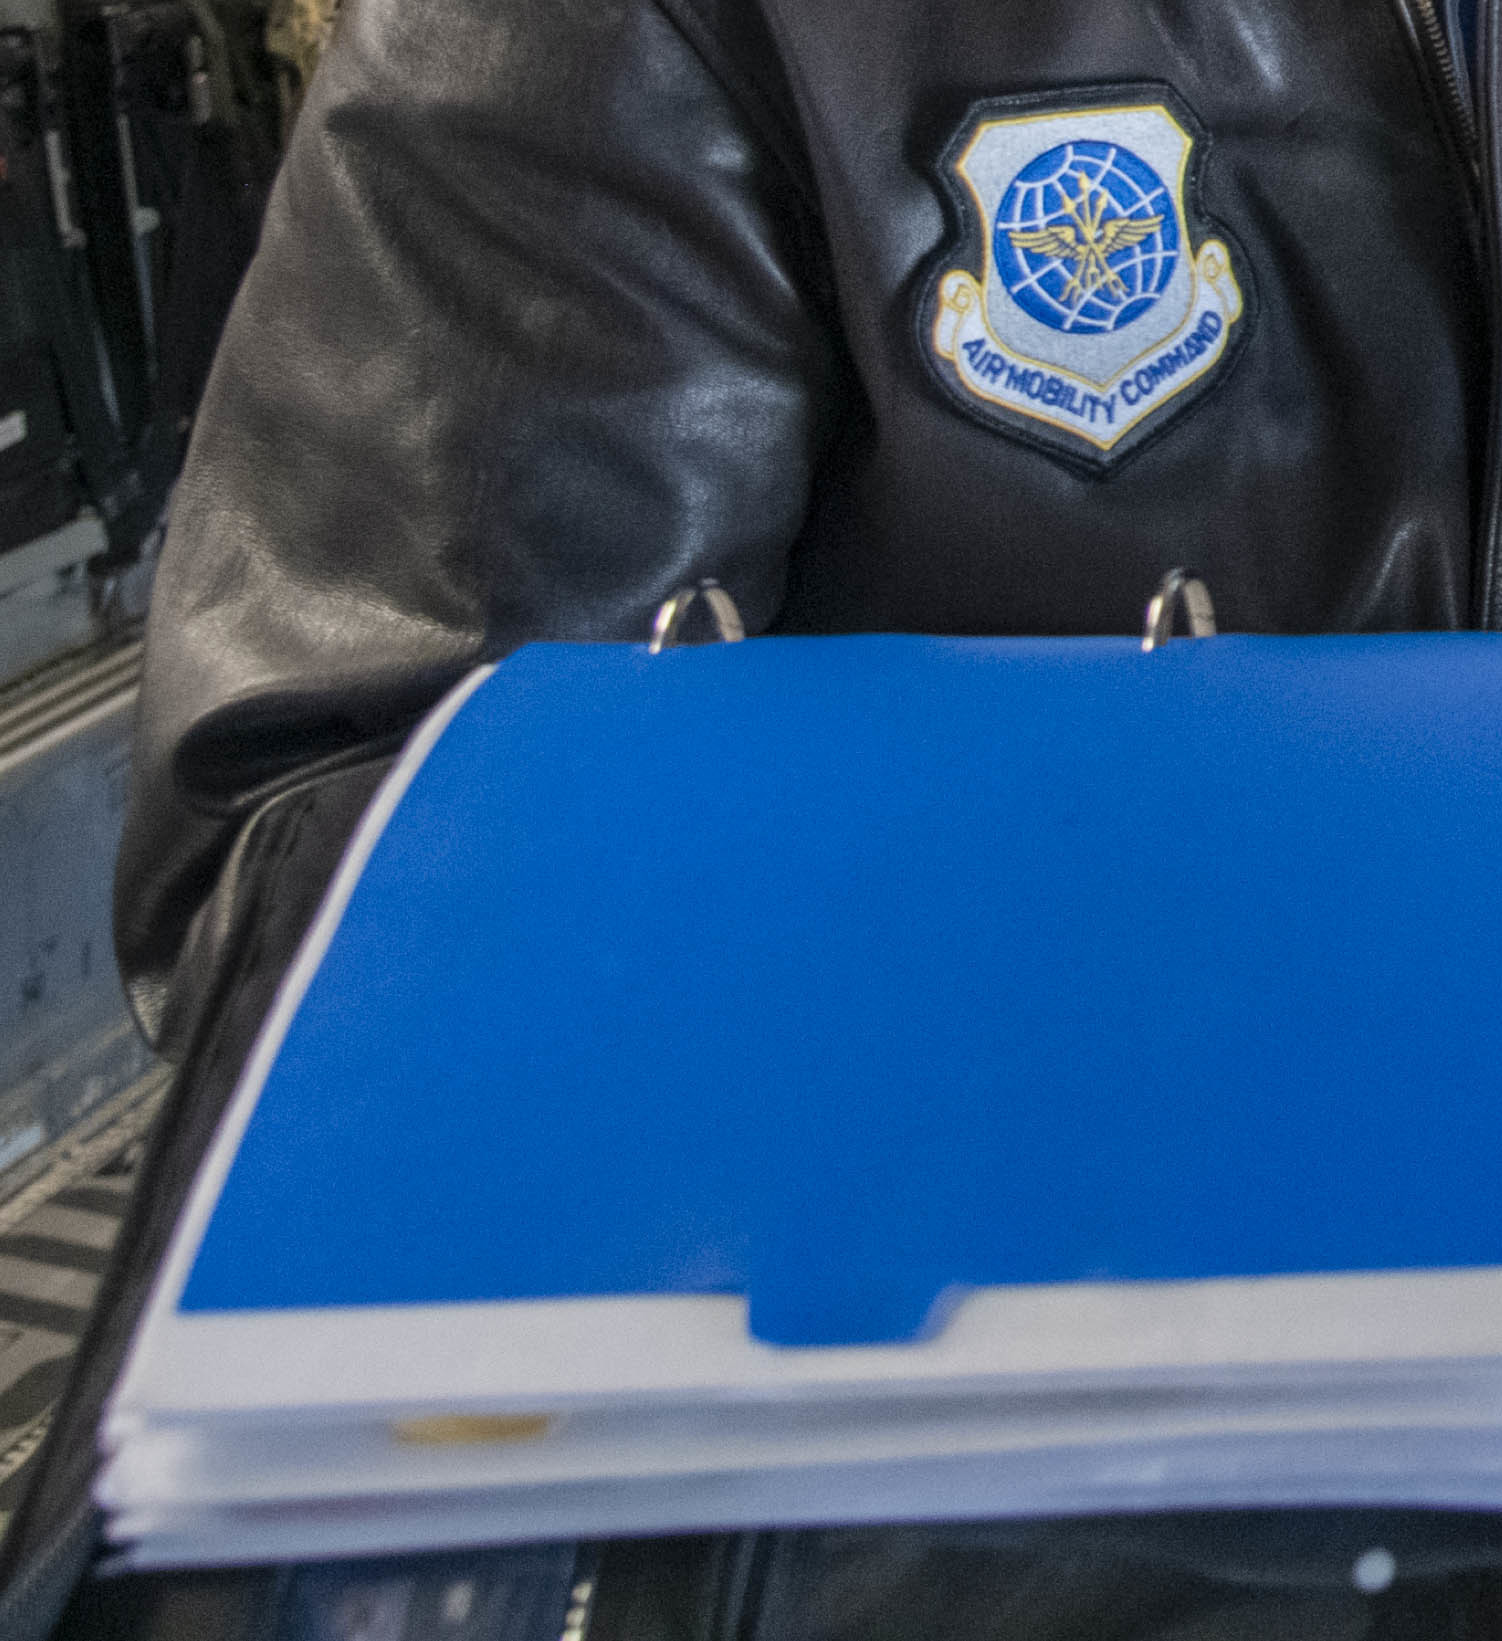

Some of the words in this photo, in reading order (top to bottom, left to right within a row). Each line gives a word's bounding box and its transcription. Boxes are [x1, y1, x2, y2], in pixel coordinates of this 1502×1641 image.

[962, 338, 1006, 381] AIR
[1006, 368, 1118, 424] MOBILITY
[1119, 310, 1223, 404] COMMAND
